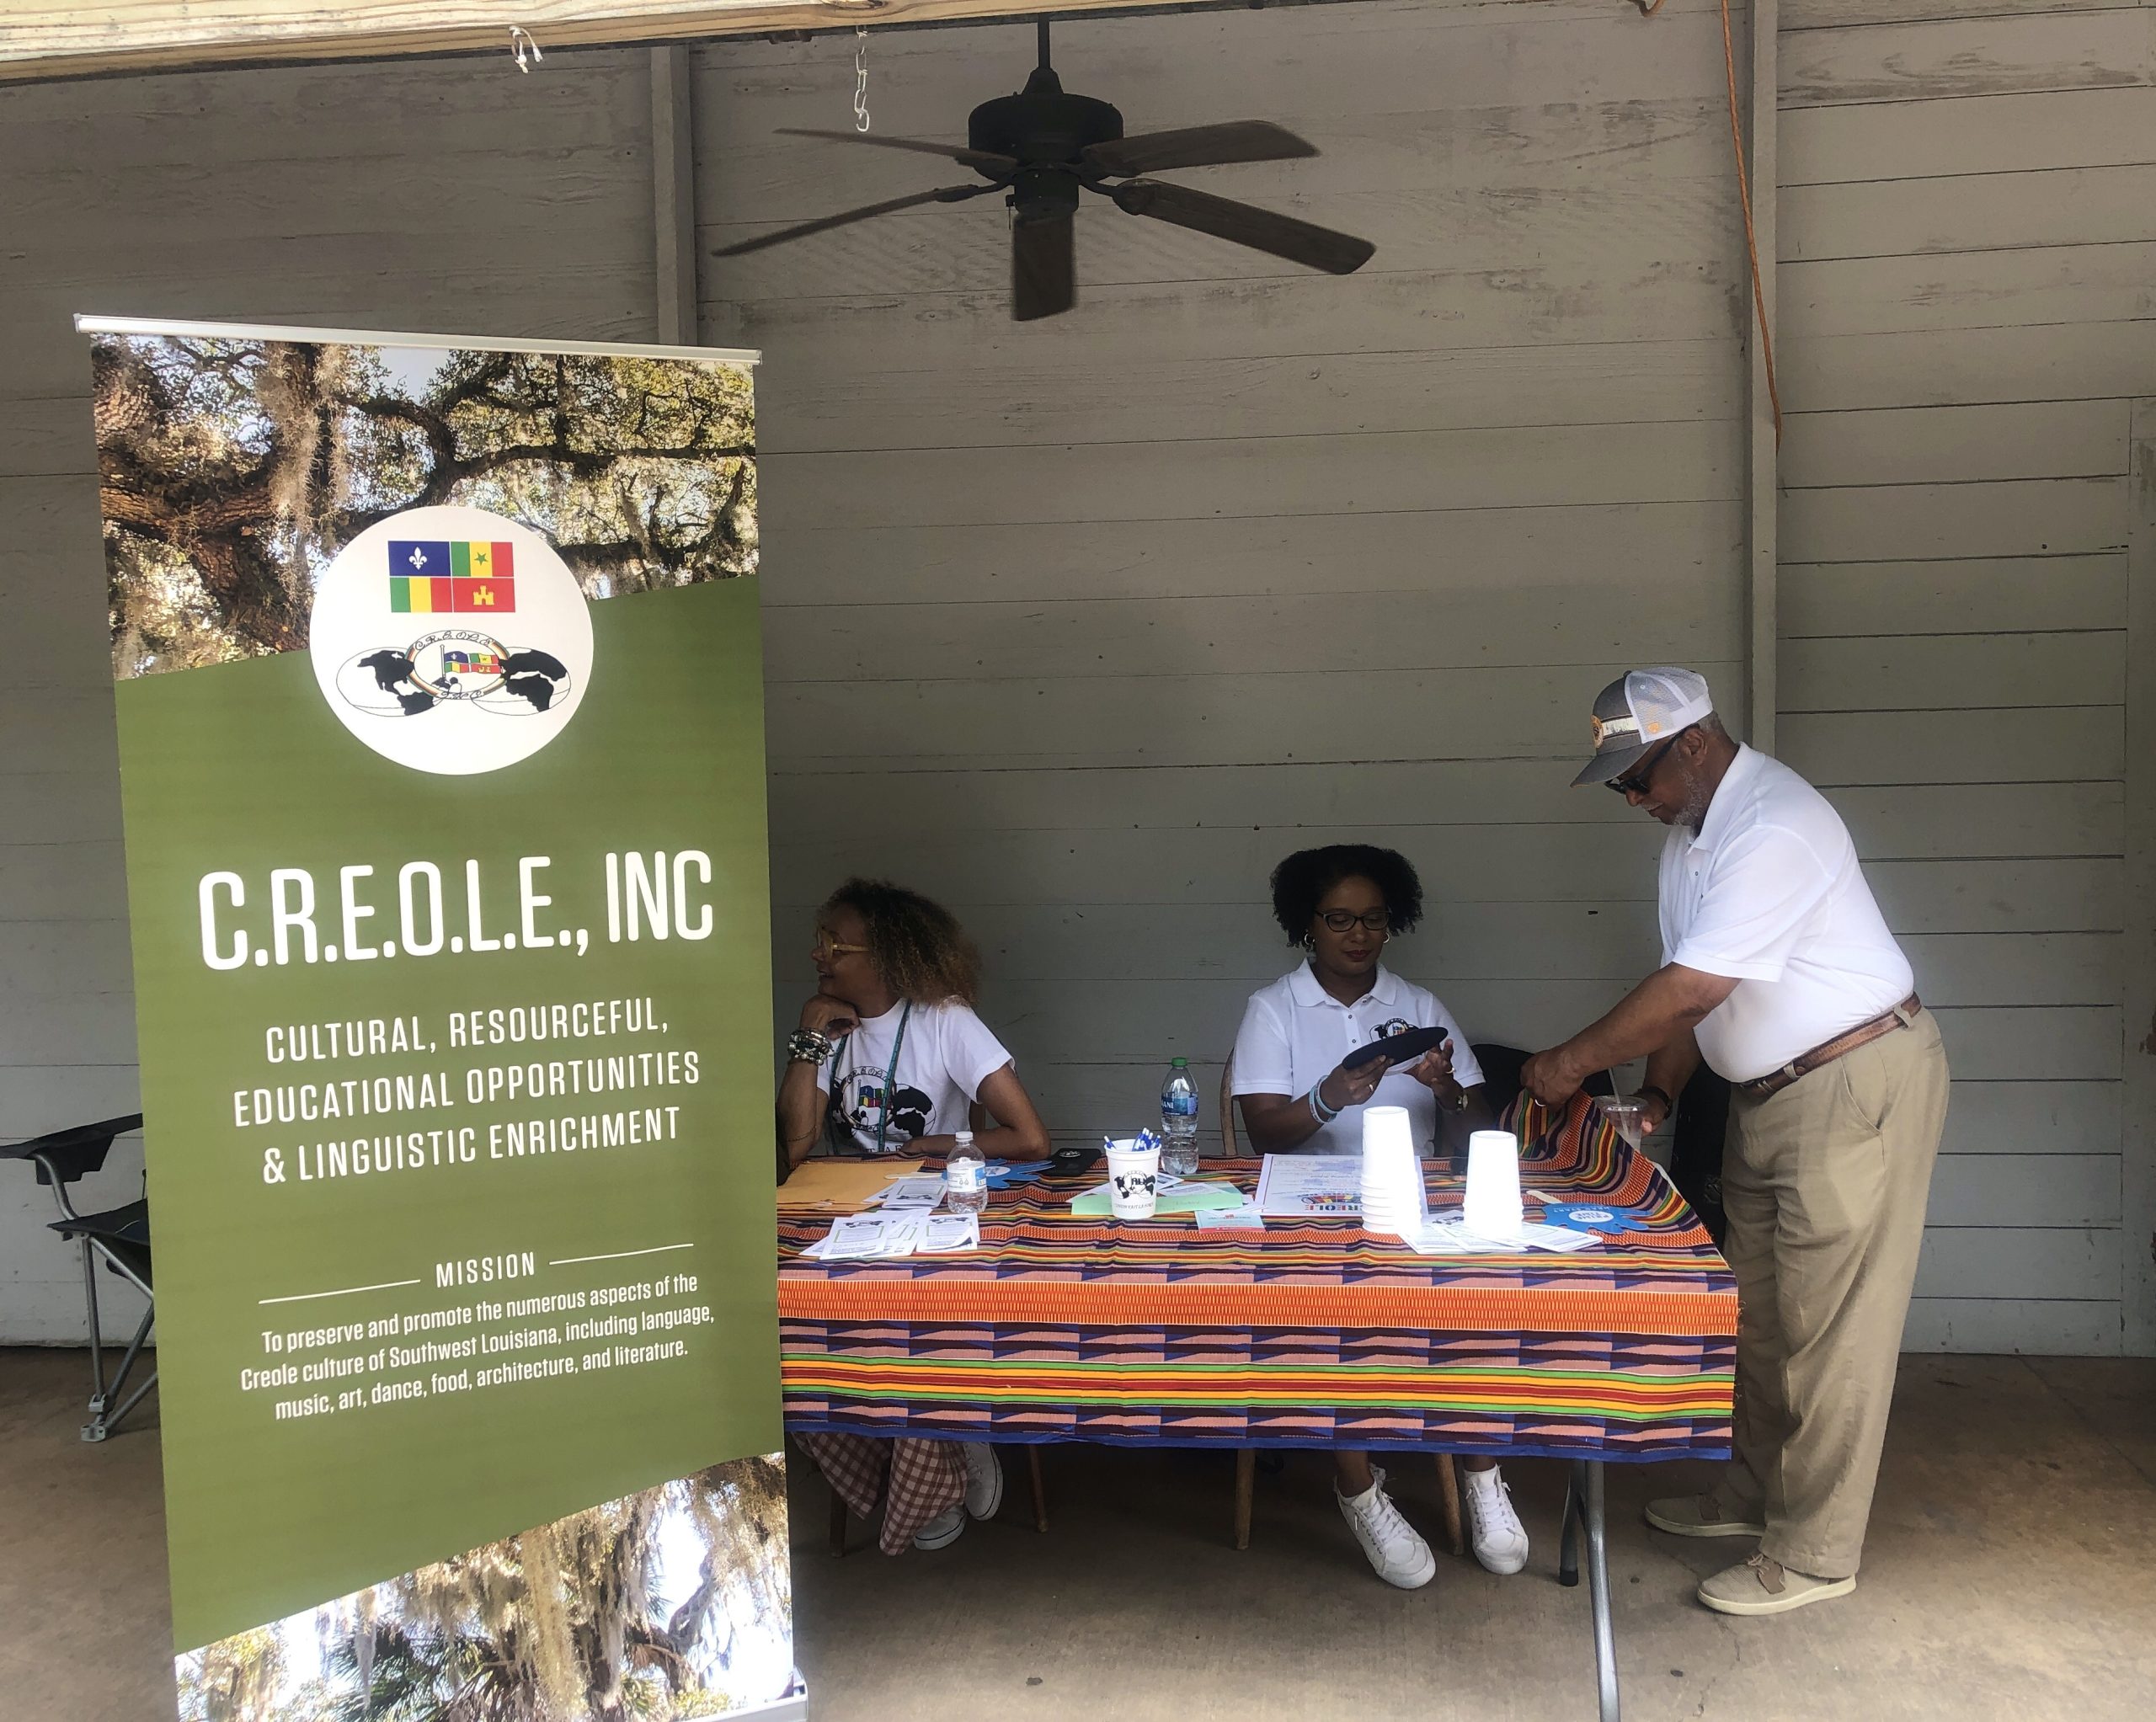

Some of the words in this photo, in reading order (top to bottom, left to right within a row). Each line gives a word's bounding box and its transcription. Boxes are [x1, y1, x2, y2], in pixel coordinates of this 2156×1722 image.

[199, 856, 589, 971] C.R.E.O.L.E.,
[606, 850, 713, 943] INC
[266, 1016, 436, 1064] CULTURAL,
[449, 997, 668, 1048] RESOURCEFUL,
[233, 1072, 454, 1128] EDUCATIONAL
[467, 1051, 699, 1104] OPPORTUNITIES
[263, 1147, 286, 1184] &
[298, 1127, 476, 1181] LINGUISTIC
[489, 1106, 680, 1160] ENRICHMENT
[435, 1251, 535, 1288] MISSION
[241, 1363, 298, 1391] Creole
[302, 1357, 364, 1382] culture
[368, 1348, 386, 1372] of
[389, 1336, 478, 1368] Southwest
[481, 1327, 562, 1354] Louisiana,
[565, 1315, 638, 1341] including
[641, 1306, 714, 1331] language,
[261, 1330, 283, 1353] To
[286, 1323, 364, 1353] preserve
[368, 1313, 399, 1338] and
[403, 1306, 472, 1335] promote
[475, 1300, 502, 1322] the
[506, 1292, 586, 1318] numerous
[590, 1282, 651, 1307] aspects
[655, 1275, 670, 1297] of
[673, 1273, 697, 1294] the
[275, 1393, 334, 1420] music,
[339, 1387, 367, 1410] art,
[371, 1380, 427, 1405] dance,
[430, 1368, 472, 1394] food,
[477, 1357, 579, 1387] architecture,
[582, 1346, 611, 1371] and
[615, 1340, 688, 1366] literature.
